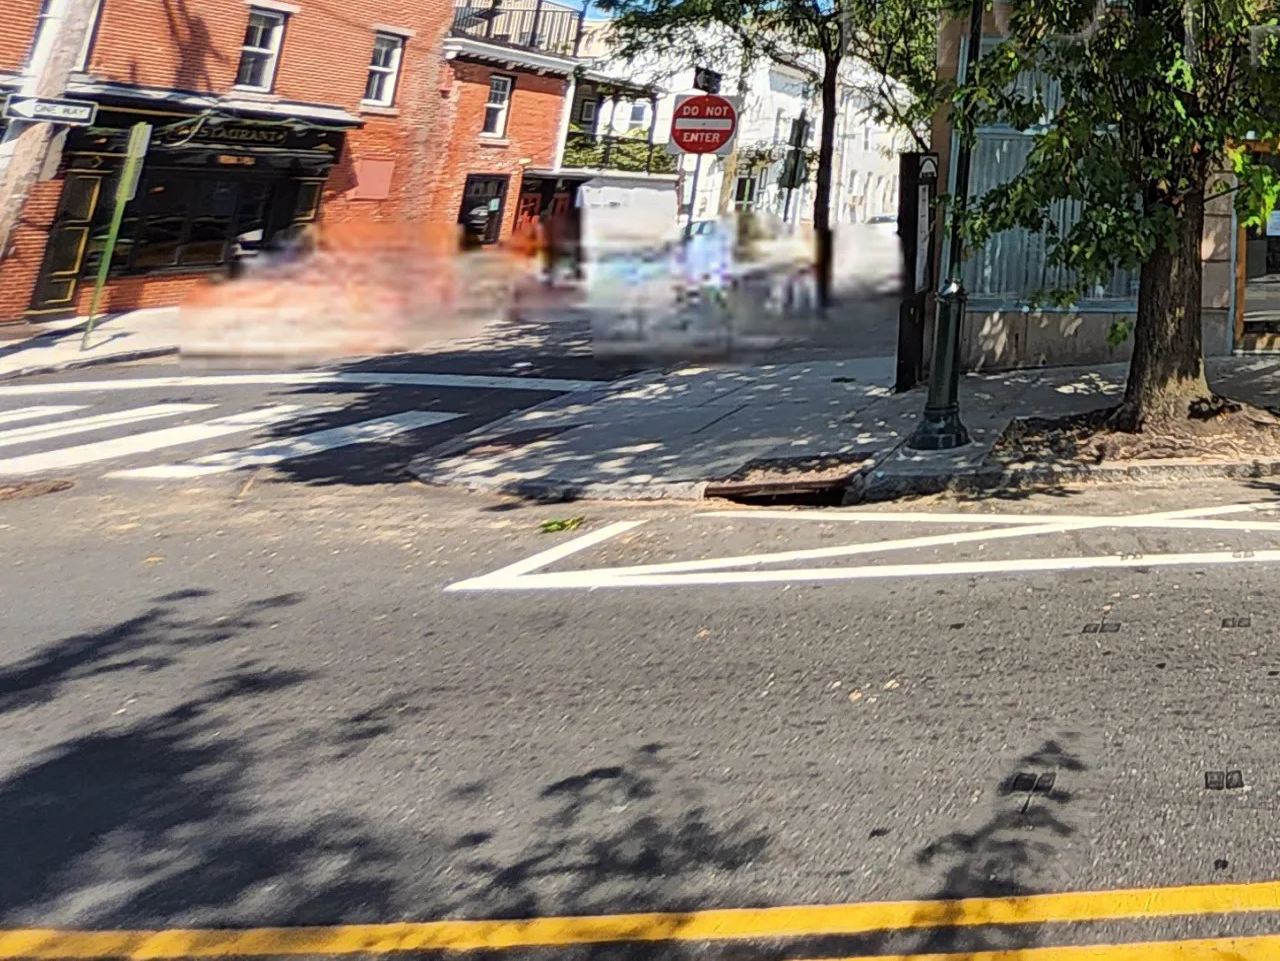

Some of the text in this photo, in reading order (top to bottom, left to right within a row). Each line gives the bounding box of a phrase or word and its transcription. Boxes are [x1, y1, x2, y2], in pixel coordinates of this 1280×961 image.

[34, 104, 87, 116] ONE WAY
[682, 106, 729, 116] DO NOT
[185, 125, 278, 143] STAURANT
[682, 132, 720, 143] ENTER
